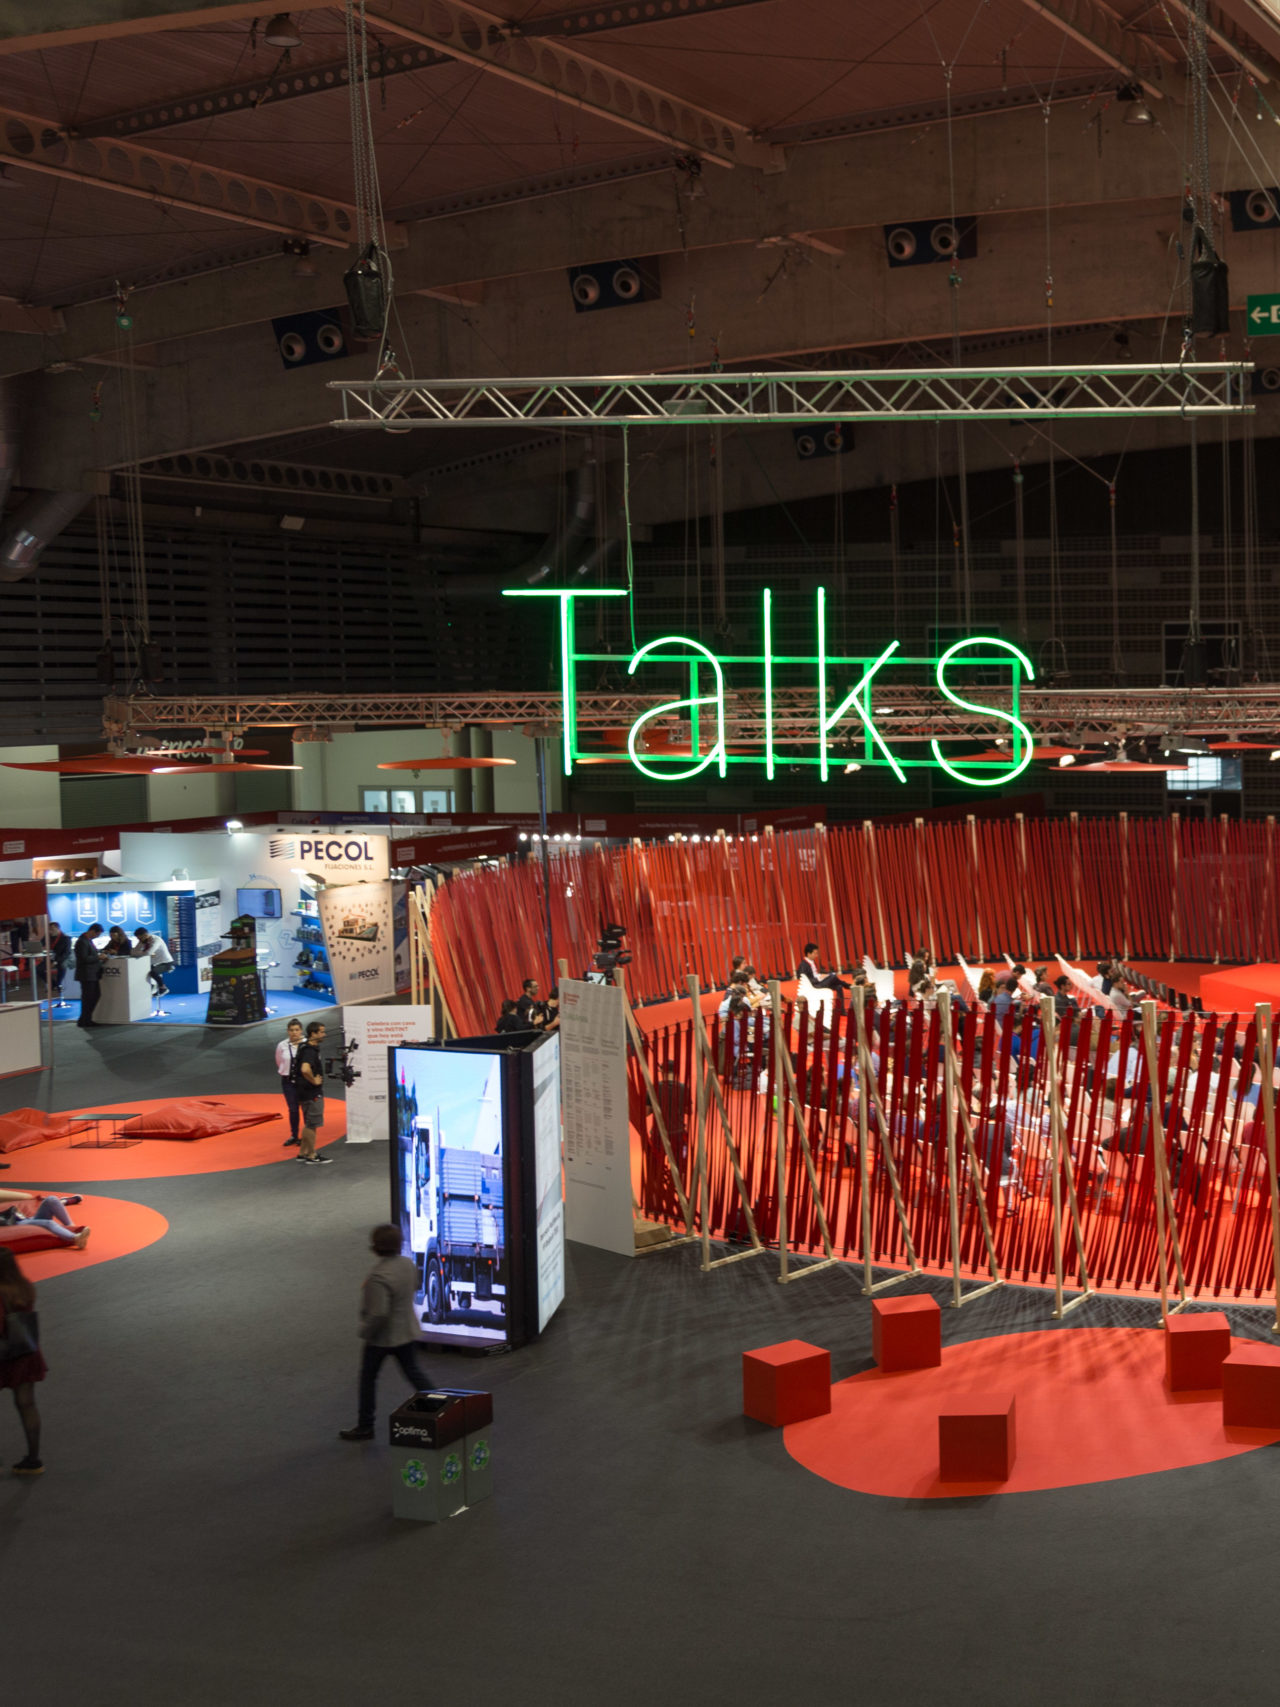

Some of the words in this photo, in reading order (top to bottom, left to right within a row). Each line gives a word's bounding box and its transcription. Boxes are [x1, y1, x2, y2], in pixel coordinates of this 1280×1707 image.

[501, 586, 1036, 787] Talks
[300, 840, 374, 861] PECOL
[357, 968, 380, 979] PECOL
